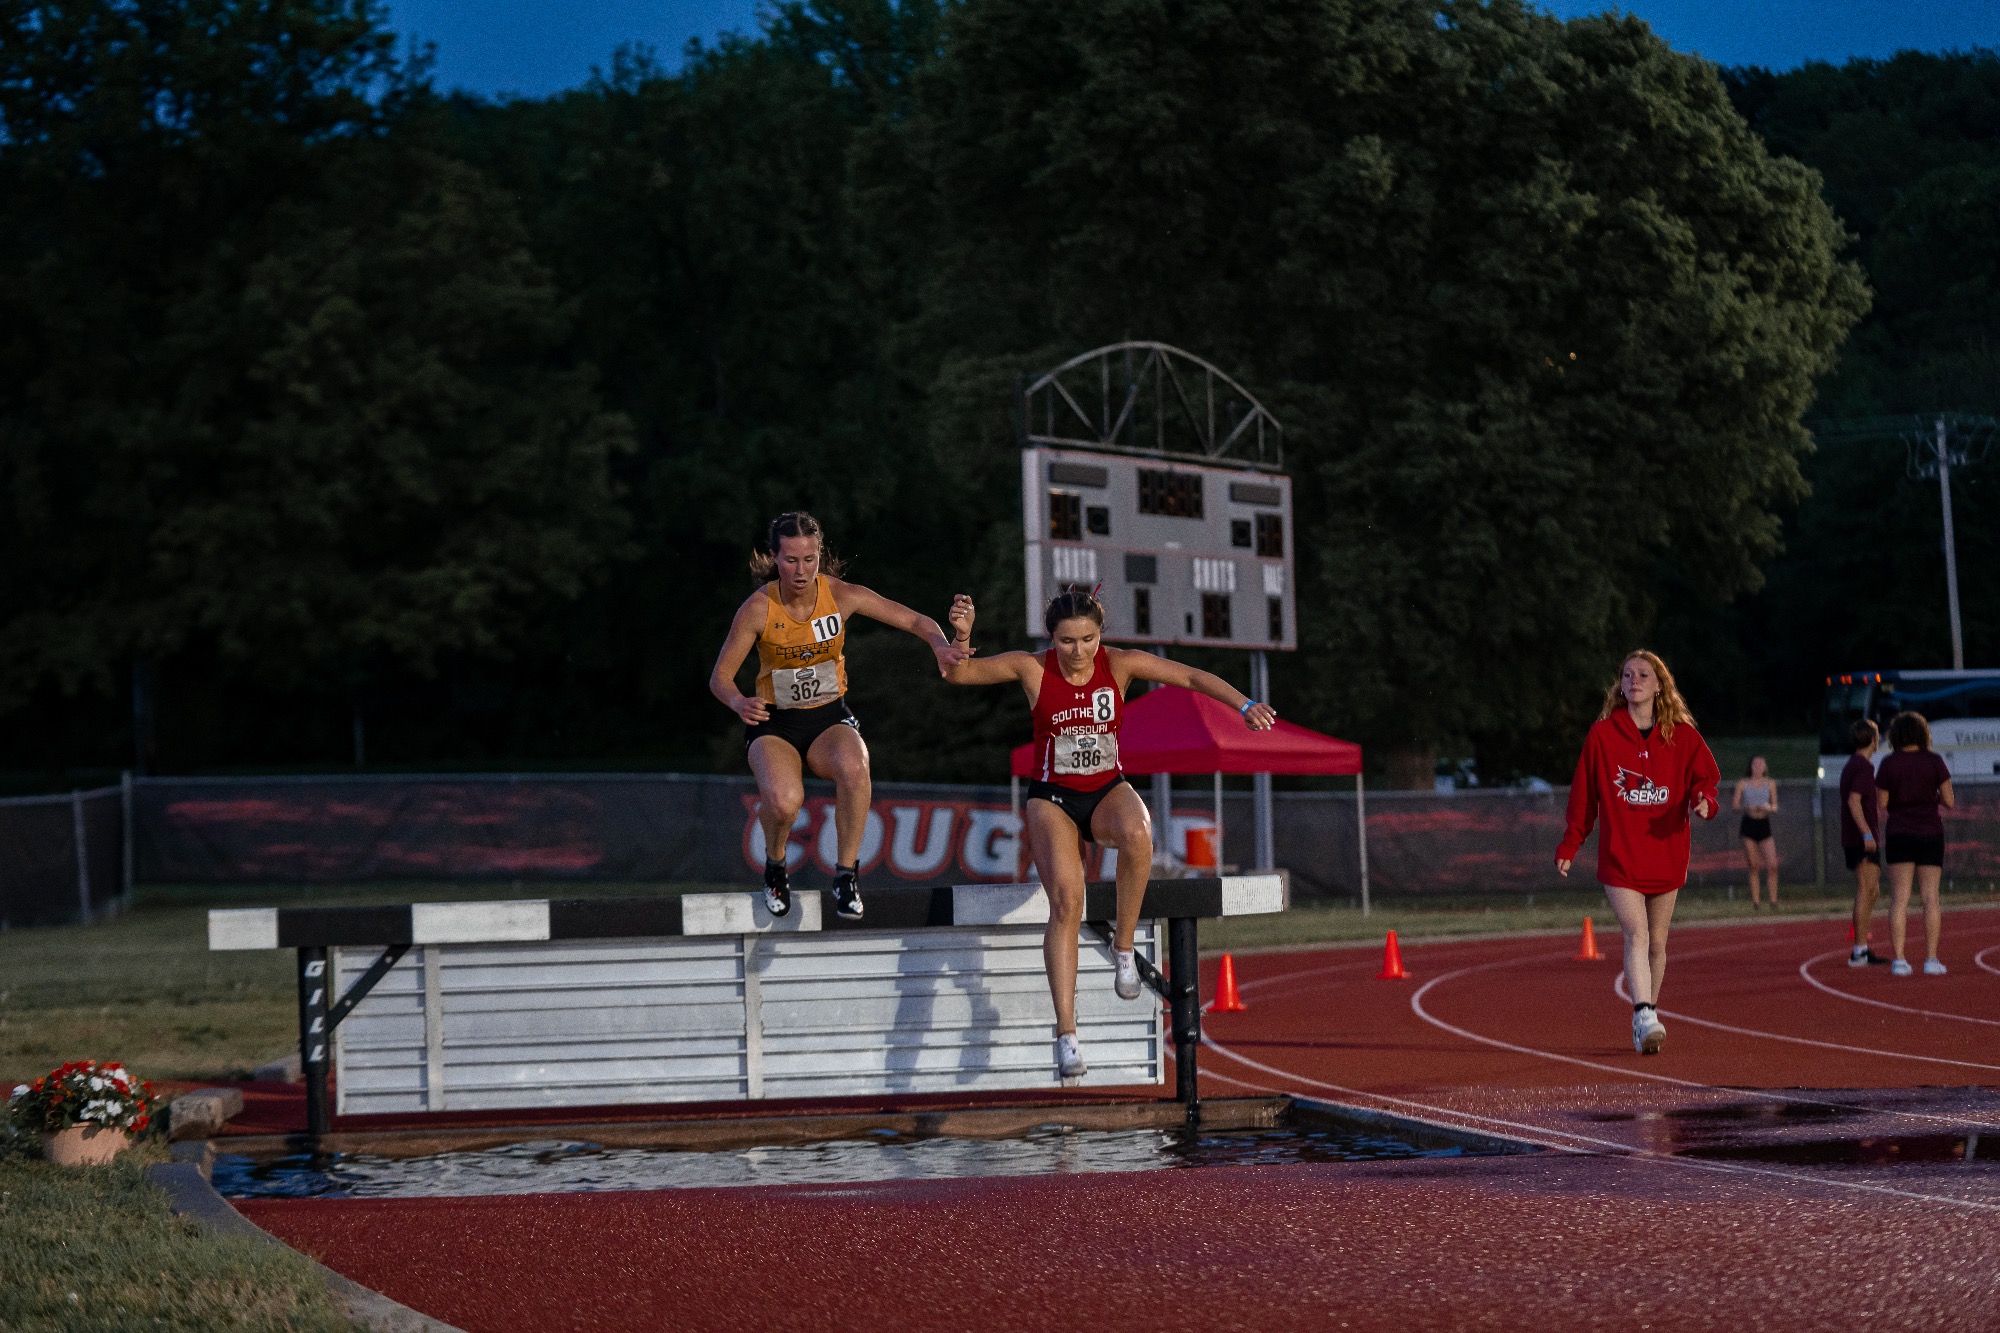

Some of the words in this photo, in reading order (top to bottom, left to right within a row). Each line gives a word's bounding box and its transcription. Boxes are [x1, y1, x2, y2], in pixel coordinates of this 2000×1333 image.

[814, 615, 839, 640] 10
[790, 679, 822, 701] 362
[1052, 706, 1094, 725] SOUTHE
[1096, 693, 1112, 721] 8
[1060, 723, 1108, 736] MISSOURI
[1955, 732, 2000, 748] VANDA
[1071, 749, 1102, 769] 386
[1628, 787, 1669, 805] SEMO
[304, 960, 326, 1062] GILL
